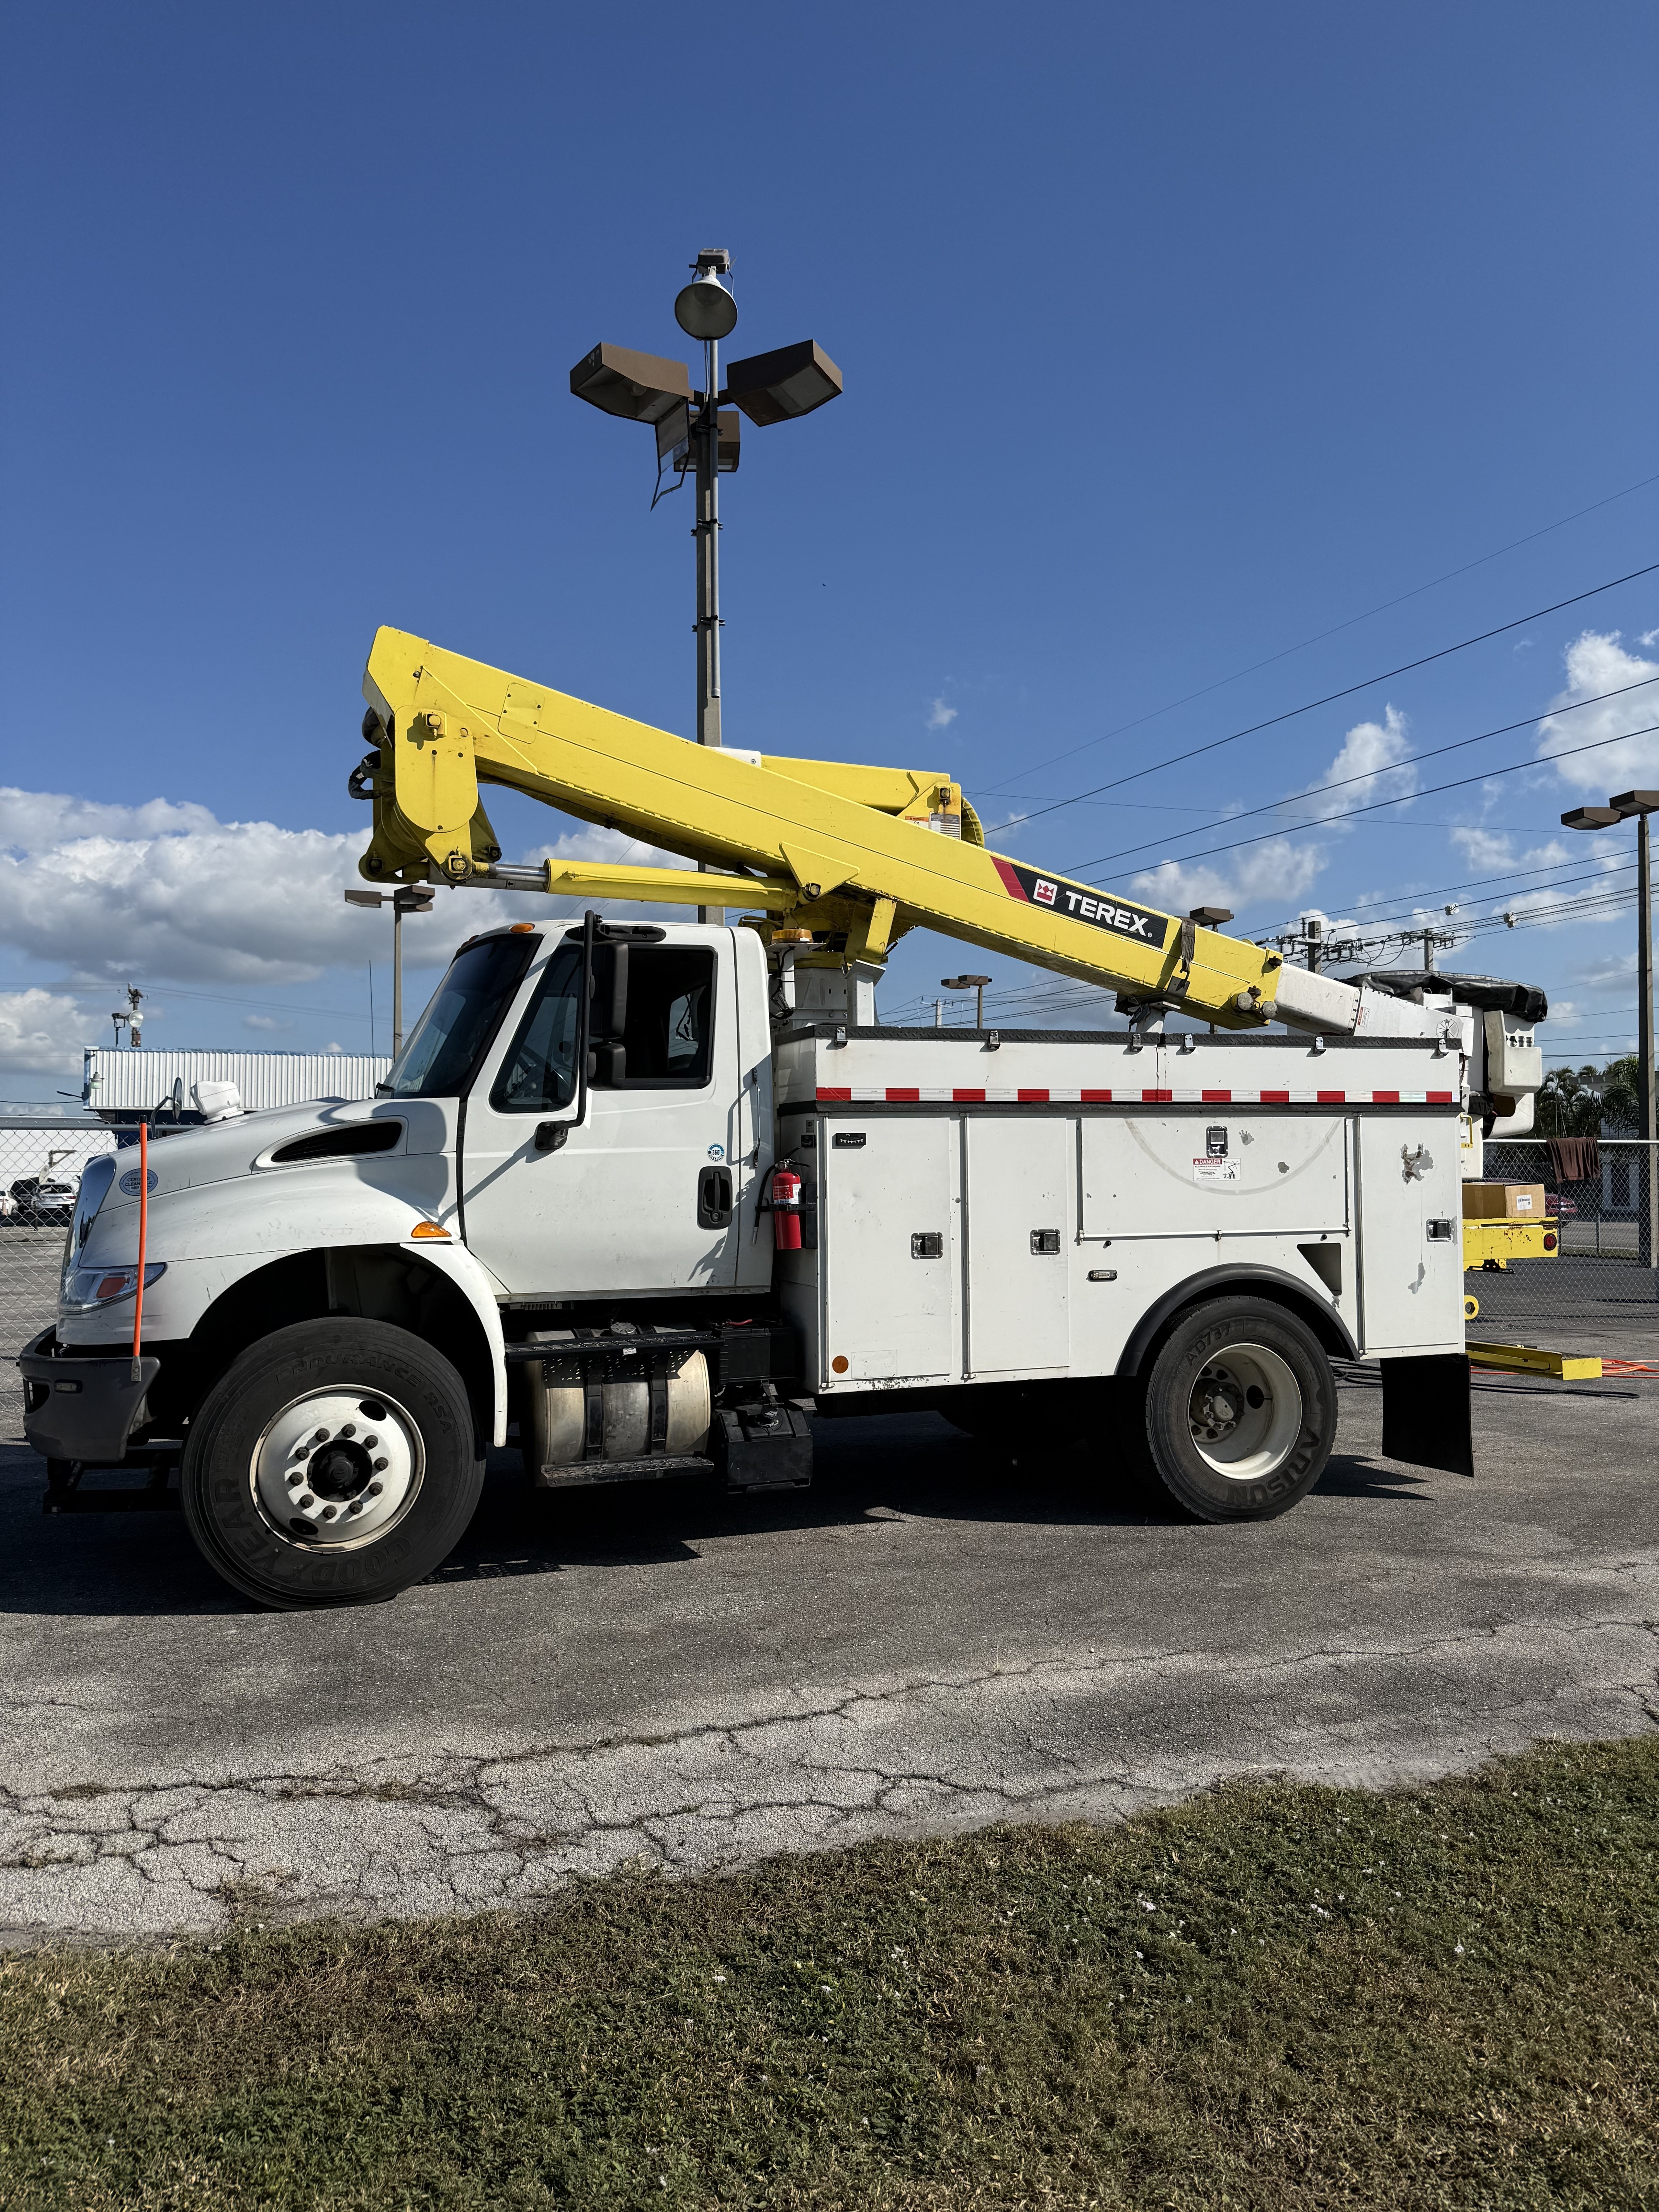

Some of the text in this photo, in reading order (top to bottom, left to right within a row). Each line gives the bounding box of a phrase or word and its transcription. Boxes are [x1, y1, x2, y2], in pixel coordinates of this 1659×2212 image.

[1184, 1322, 1232, 1367] AD737
[275, 1353, 423, 1388] ENDURANCE
[1227, 1426, 1320, 1506] ARISUN
